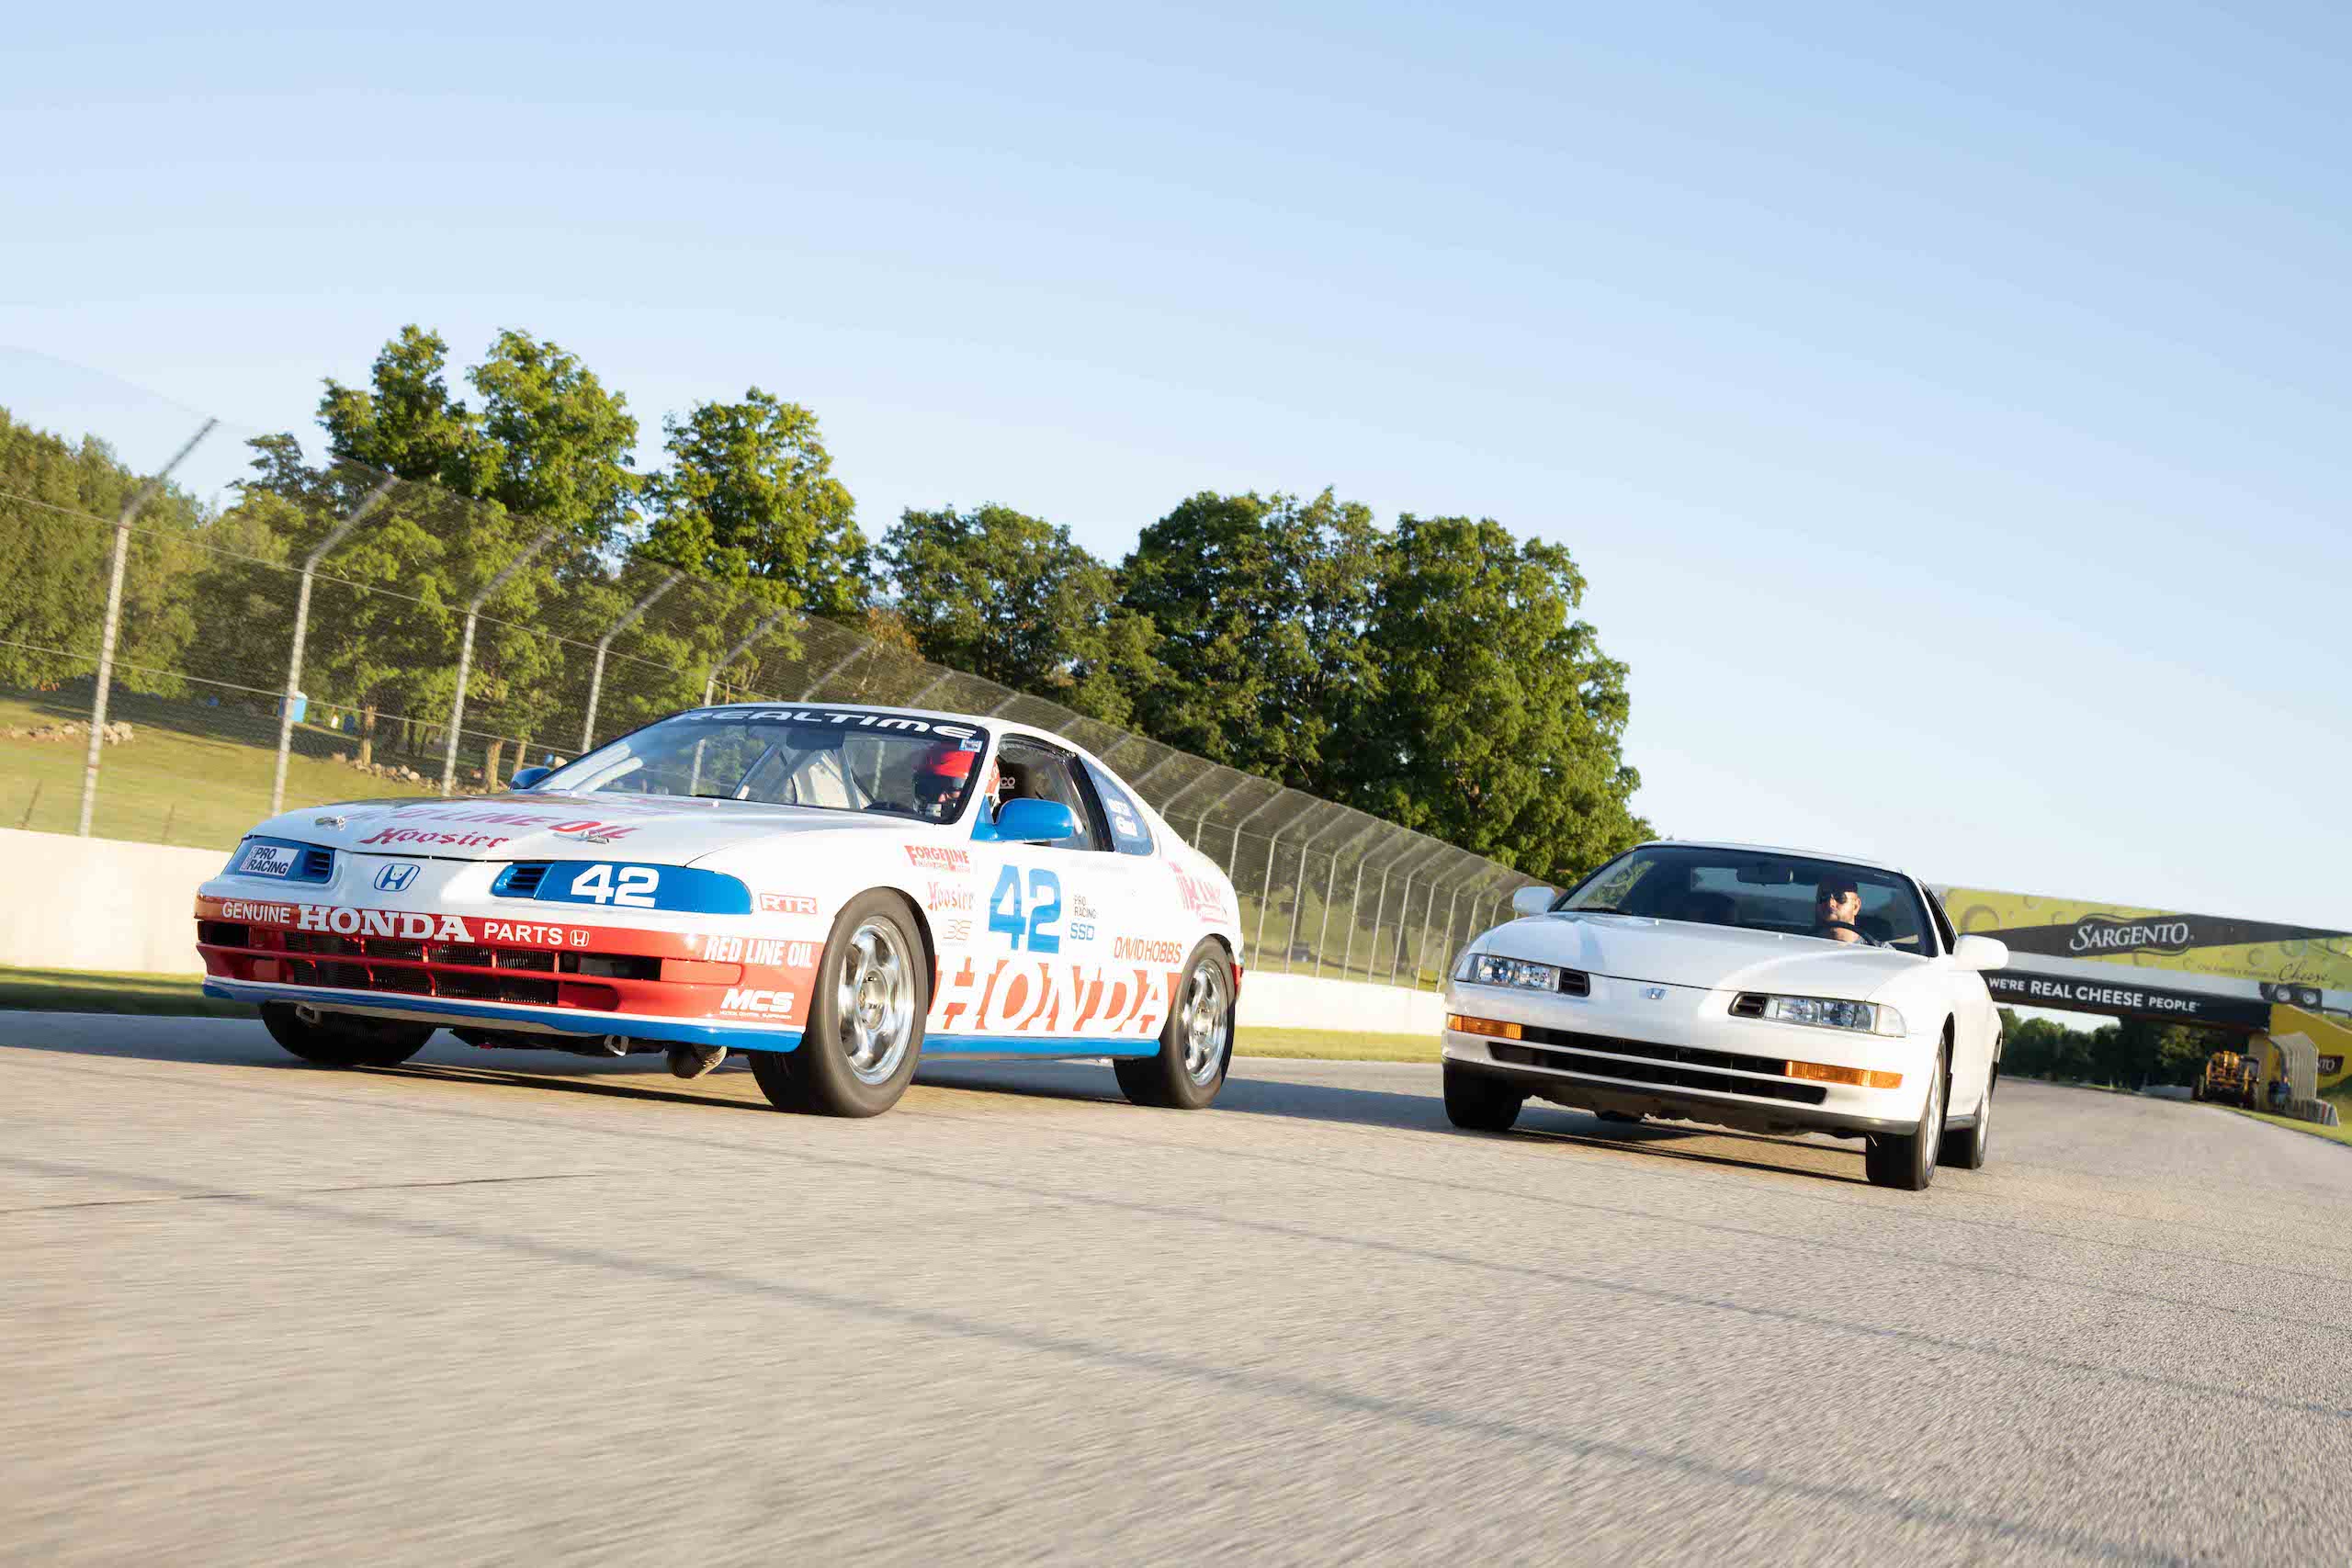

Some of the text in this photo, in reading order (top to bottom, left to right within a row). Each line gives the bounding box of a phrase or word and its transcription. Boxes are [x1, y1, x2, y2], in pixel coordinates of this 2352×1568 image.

[678, 710, 978, 739] REALTIME
[246, 859, 288, 874] RACING
[254, 846, 277, 860] PRO
[571, 863, 660, 908] 42
[761, 894, 816, 914] RTR
[988, 864, 1061, 954] 42
[221, 901, 563, 945] GENUINE HONDA PARTS
[1069, 922, 1095, 941] SSD
[2069, 922, 2189, 951] SARGENTO
[704, 936, 813, 967] RED LINE OIL
[1114, 936, 1182, 964] DAVID HOBBS
[720, 987, 795, 1013] MCS
[926, 953, 1181, 1036] HONDA
[1989, 976, 2025, 991] WE'RE
[2030, 980, 2073, 998] REAL
[2075, 986, 2143, 1008] CHEESE
